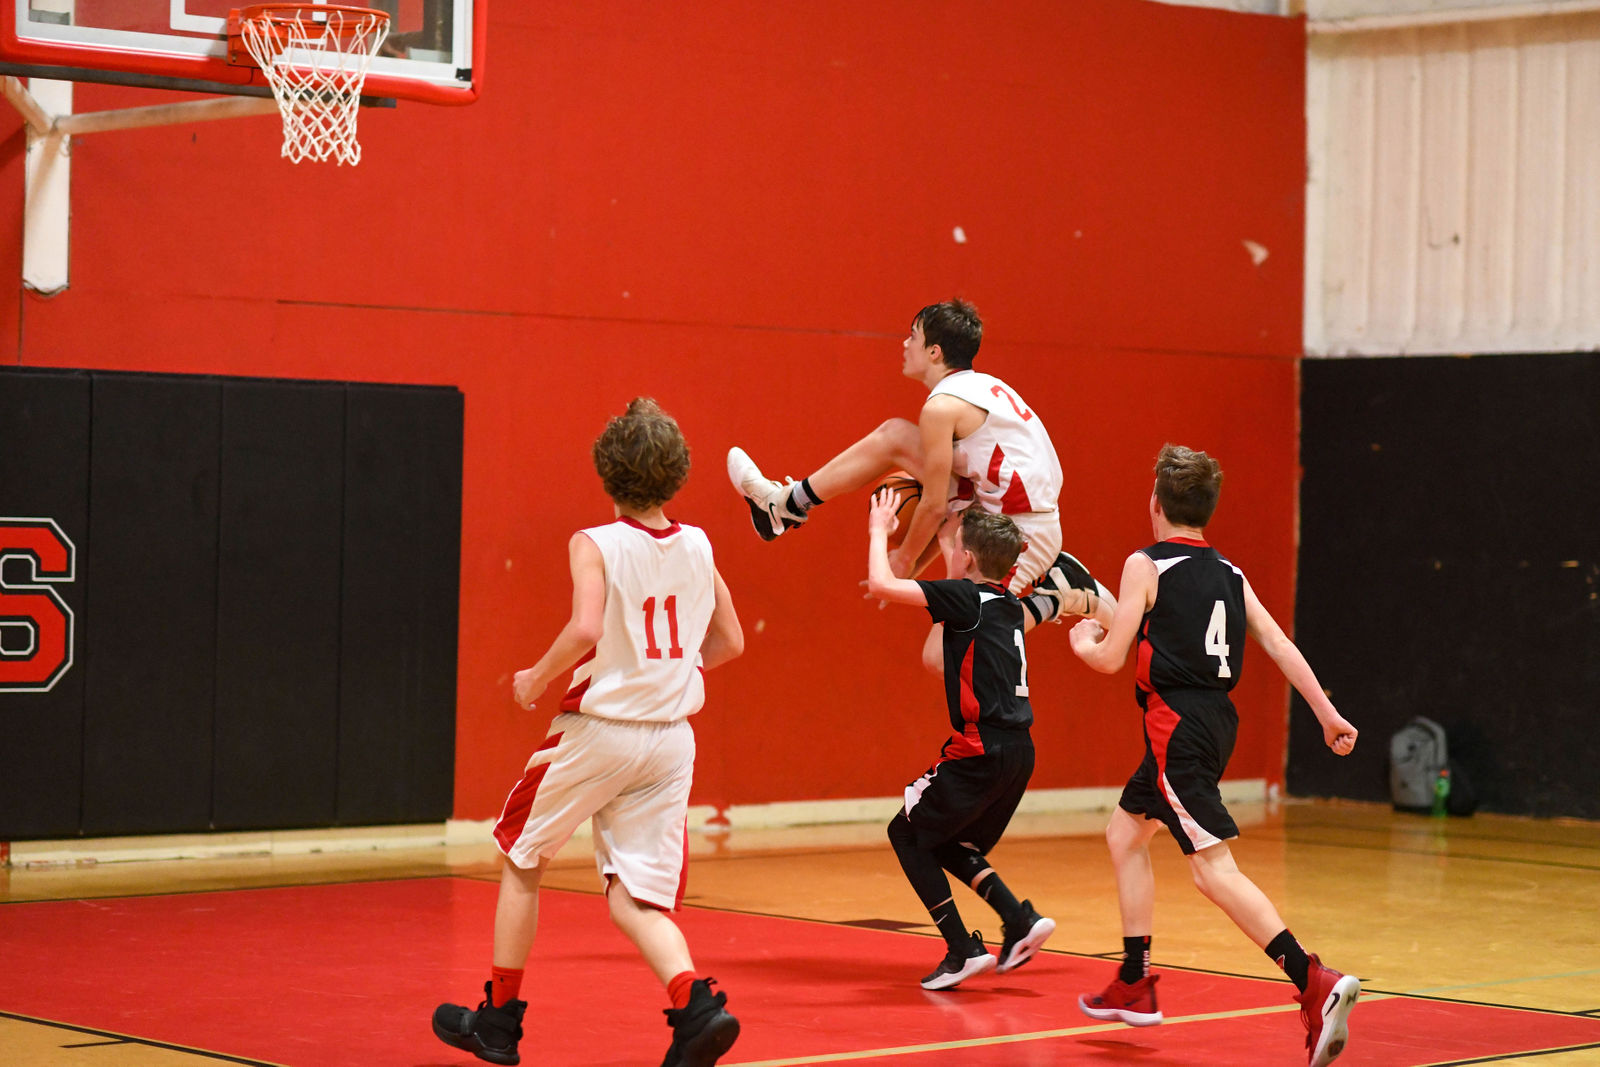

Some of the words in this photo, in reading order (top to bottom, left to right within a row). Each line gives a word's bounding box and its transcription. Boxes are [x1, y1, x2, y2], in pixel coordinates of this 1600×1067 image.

[990, 385, 1033, 422] 2
[642, 595, 684, 660] 11
[1204, 600, 1232, 679] 4
[1013, 628, 1030, 698] 1
